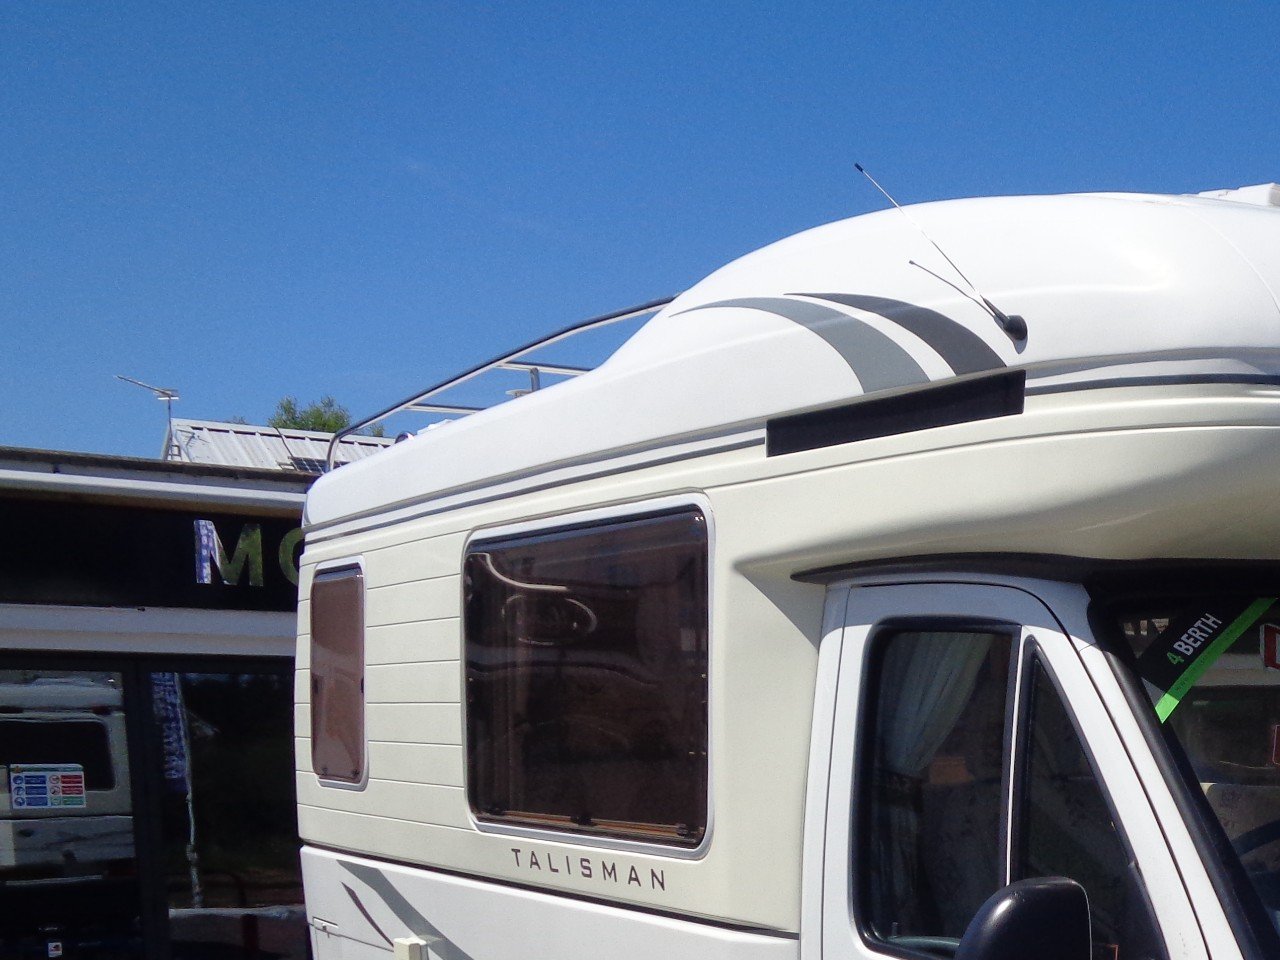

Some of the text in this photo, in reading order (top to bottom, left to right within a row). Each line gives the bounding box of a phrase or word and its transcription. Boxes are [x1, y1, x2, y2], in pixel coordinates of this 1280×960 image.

[1173, 612, 1223, 656] BERTH
[1166, 651, 1185, 665] 4
[511, 848, 666, 892] TALISMAN
